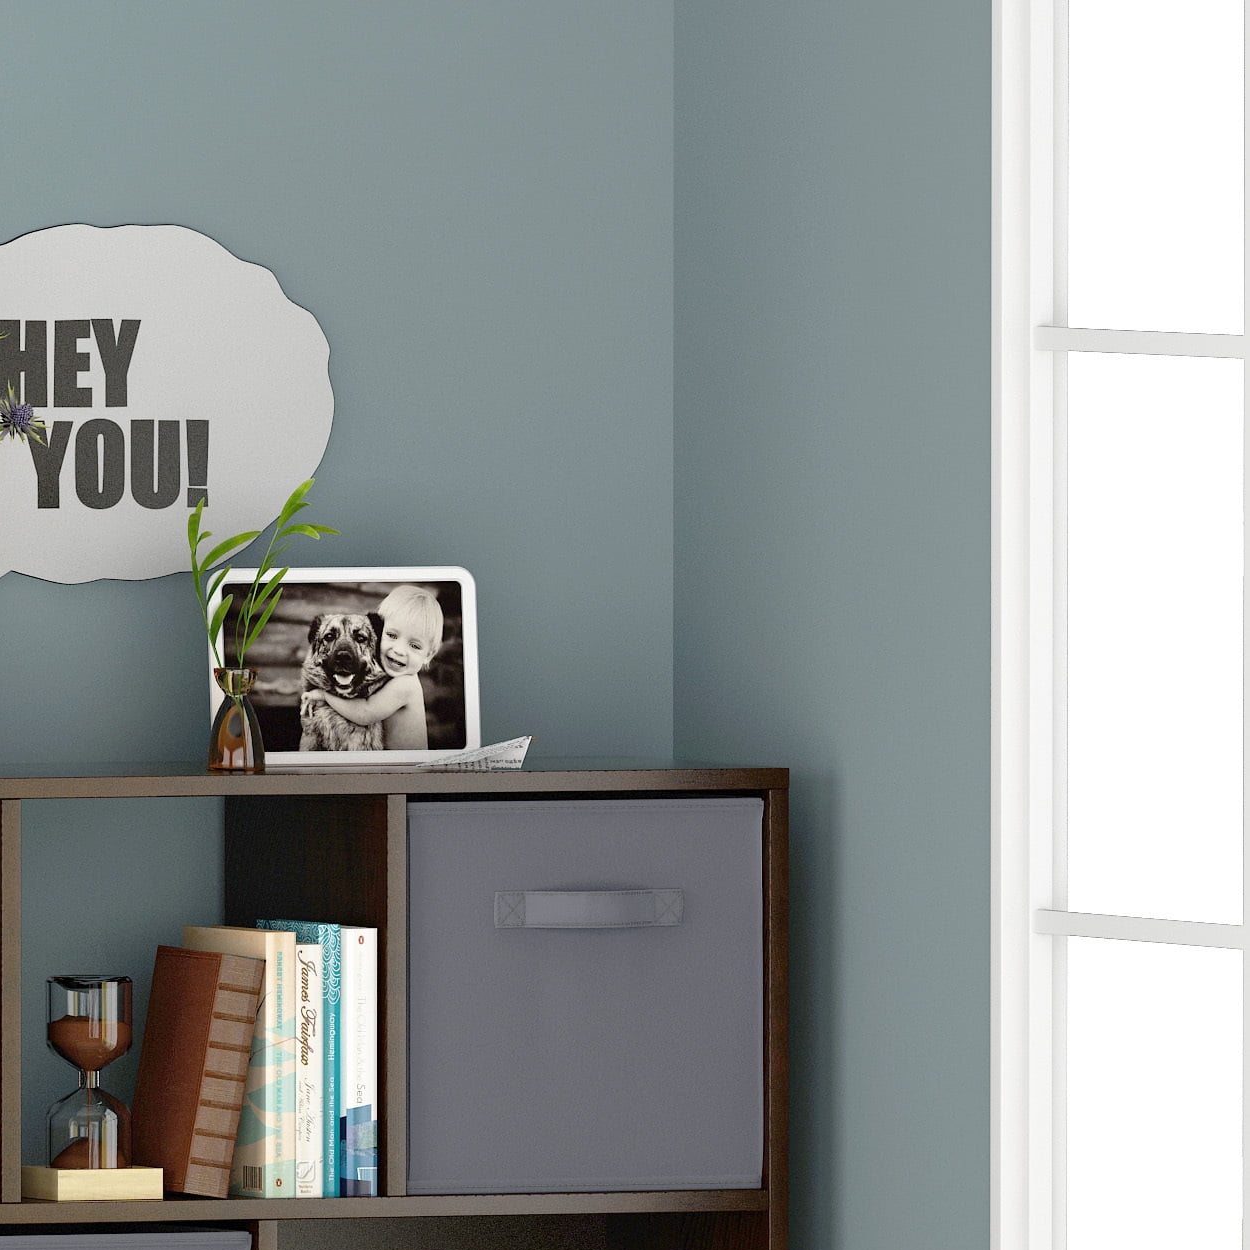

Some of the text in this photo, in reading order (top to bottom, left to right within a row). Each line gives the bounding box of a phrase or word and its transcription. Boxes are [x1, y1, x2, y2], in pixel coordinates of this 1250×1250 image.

[27, 418, 210, 510] YOU!
[296, 950, 317, 1065] James Fairfax
[328, 1013, 336, 1061] Hemingway
[356, 1083, 366, 1104] Sea
